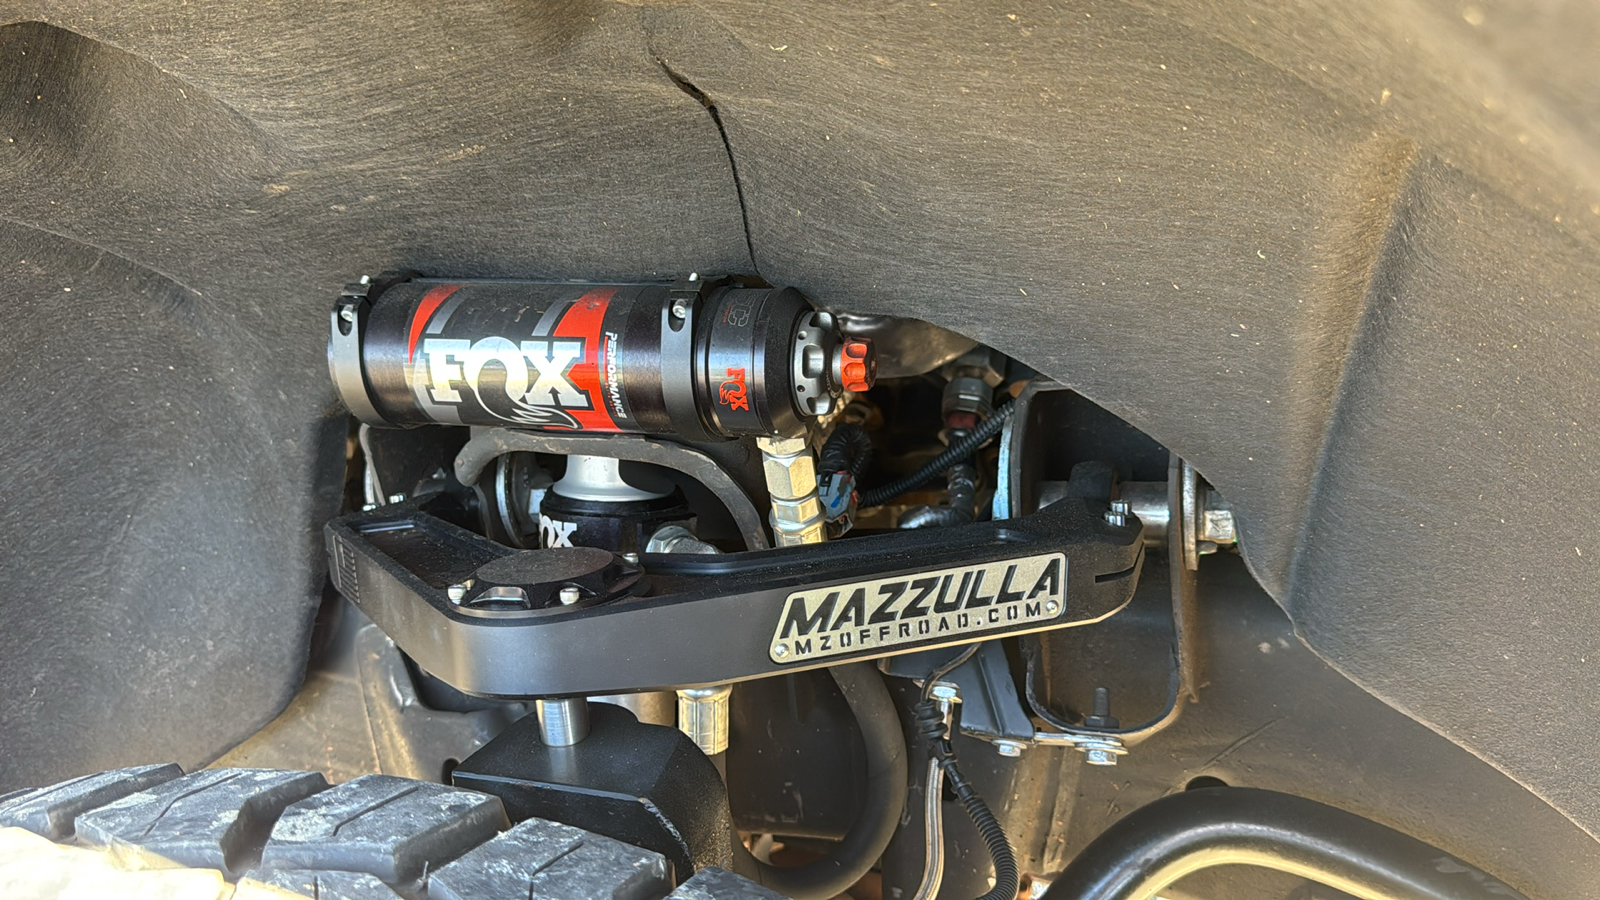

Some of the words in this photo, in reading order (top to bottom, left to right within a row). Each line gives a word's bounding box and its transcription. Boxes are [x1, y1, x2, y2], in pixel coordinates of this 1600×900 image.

[423, 336, 589, 429] FOX
[605, 331, 628, 419] PERFORMANCE
[719, 367, 749, 411] FOX
[539, 513, 577, 549] OX
[779, 558, 1061, 639] MAZZULLA
[794, 601, 1042, 655] MZOFFROAD.COM
